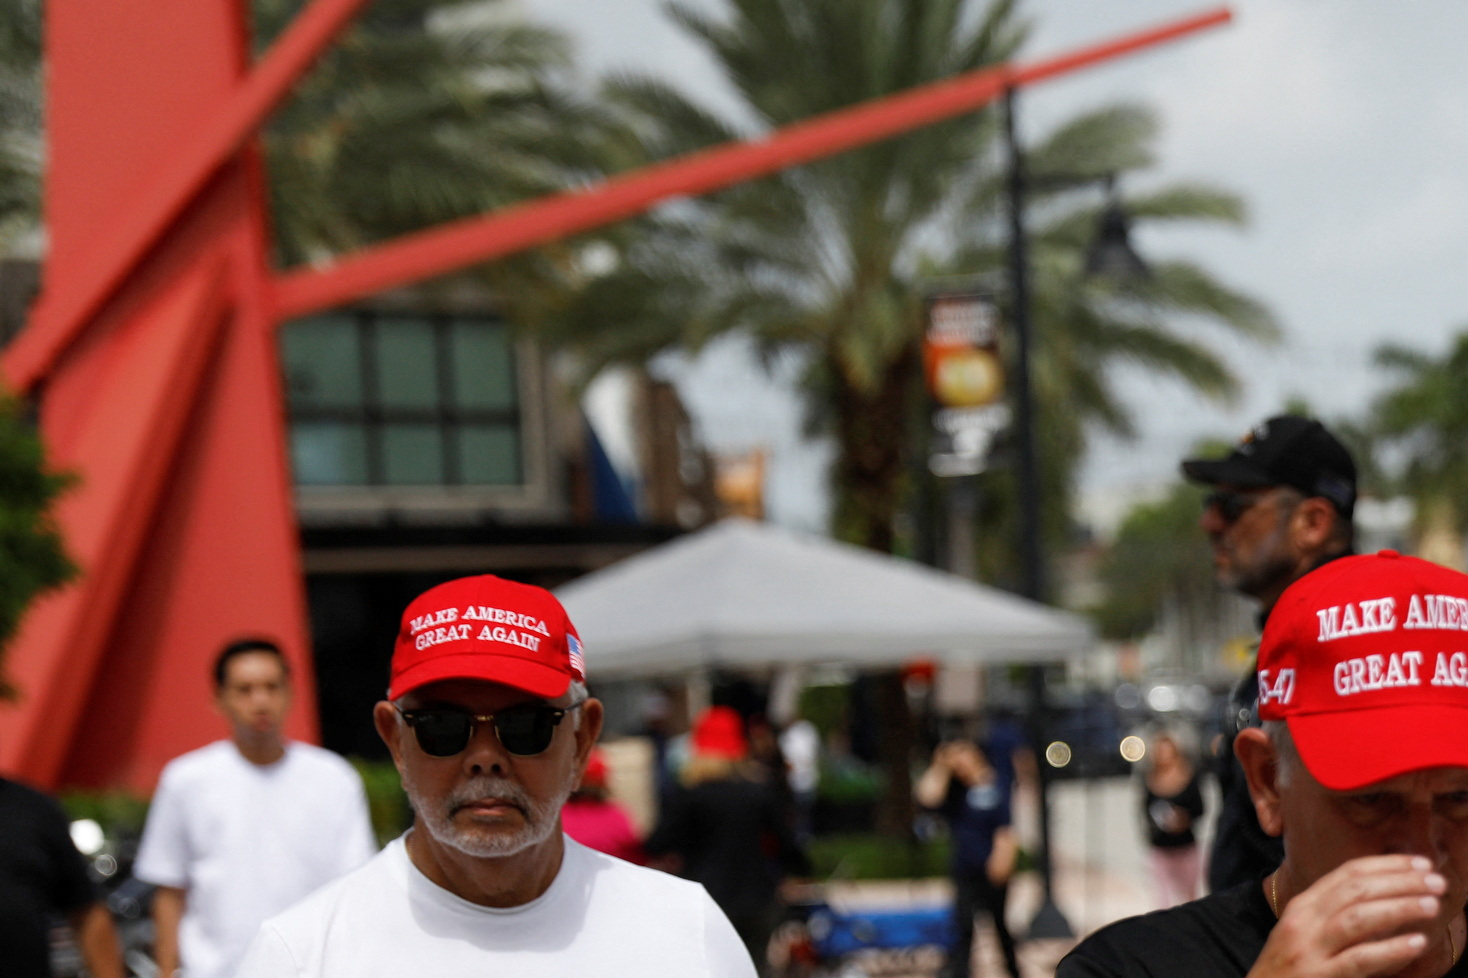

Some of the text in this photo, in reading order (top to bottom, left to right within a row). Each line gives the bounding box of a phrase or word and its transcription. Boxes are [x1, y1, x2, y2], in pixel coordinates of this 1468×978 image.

[410, 605, 551, 637] MAKE AMERICA
[1316, 597, 1397, 641] MAKE
[415, 624, 541, 652] GREAT AGAIN
[1258, 668, 1295, 704] 5-47
[1334, 651, 1422, 695] GREAT
